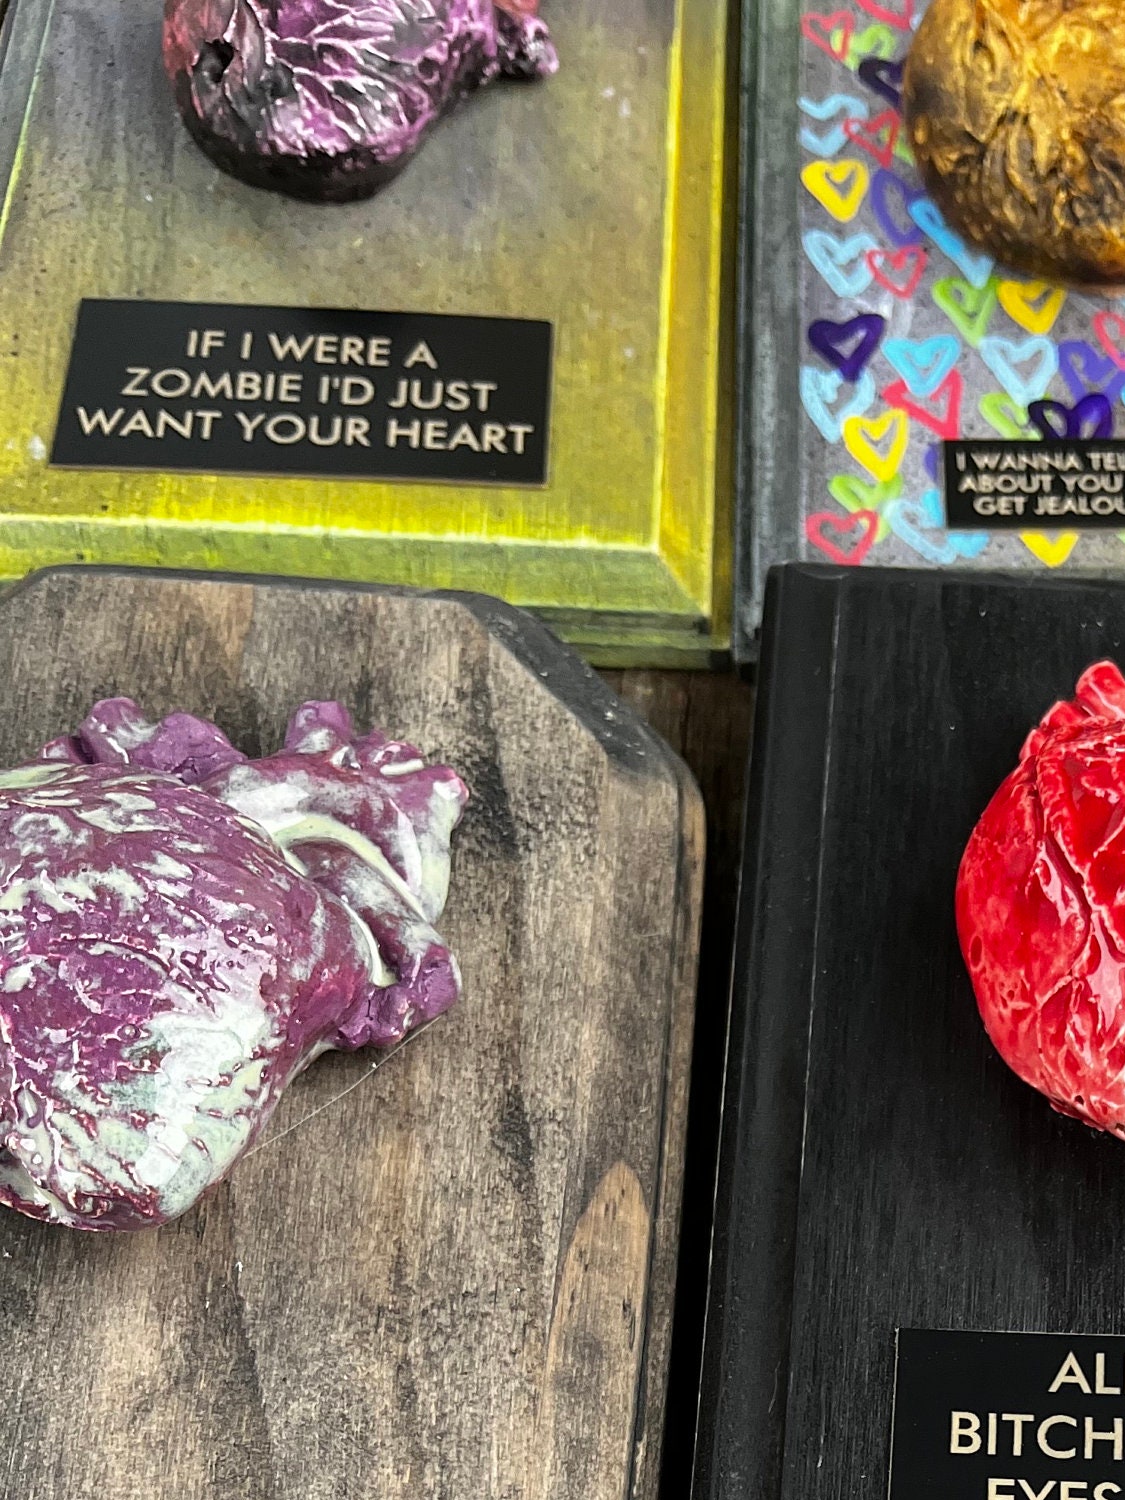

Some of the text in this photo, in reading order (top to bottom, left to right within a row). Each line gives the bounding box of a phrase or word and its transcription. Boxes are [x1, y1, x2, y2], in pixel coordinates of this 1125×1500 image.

[186, 330, 438, 370] IF I WERE A
[121, 367, 498, 412] ZOMBIE I'D JUST
[77, 406, 534, 455] WANT YOUR HEART
[956, 452, 965, 471] I
[970, 452, 1081, 471] WANNA
[959, 473, 1054, 494] ABOUT
[1060, 474, 1124, 494] YOU
[973, 496, 1028, 516] GET
